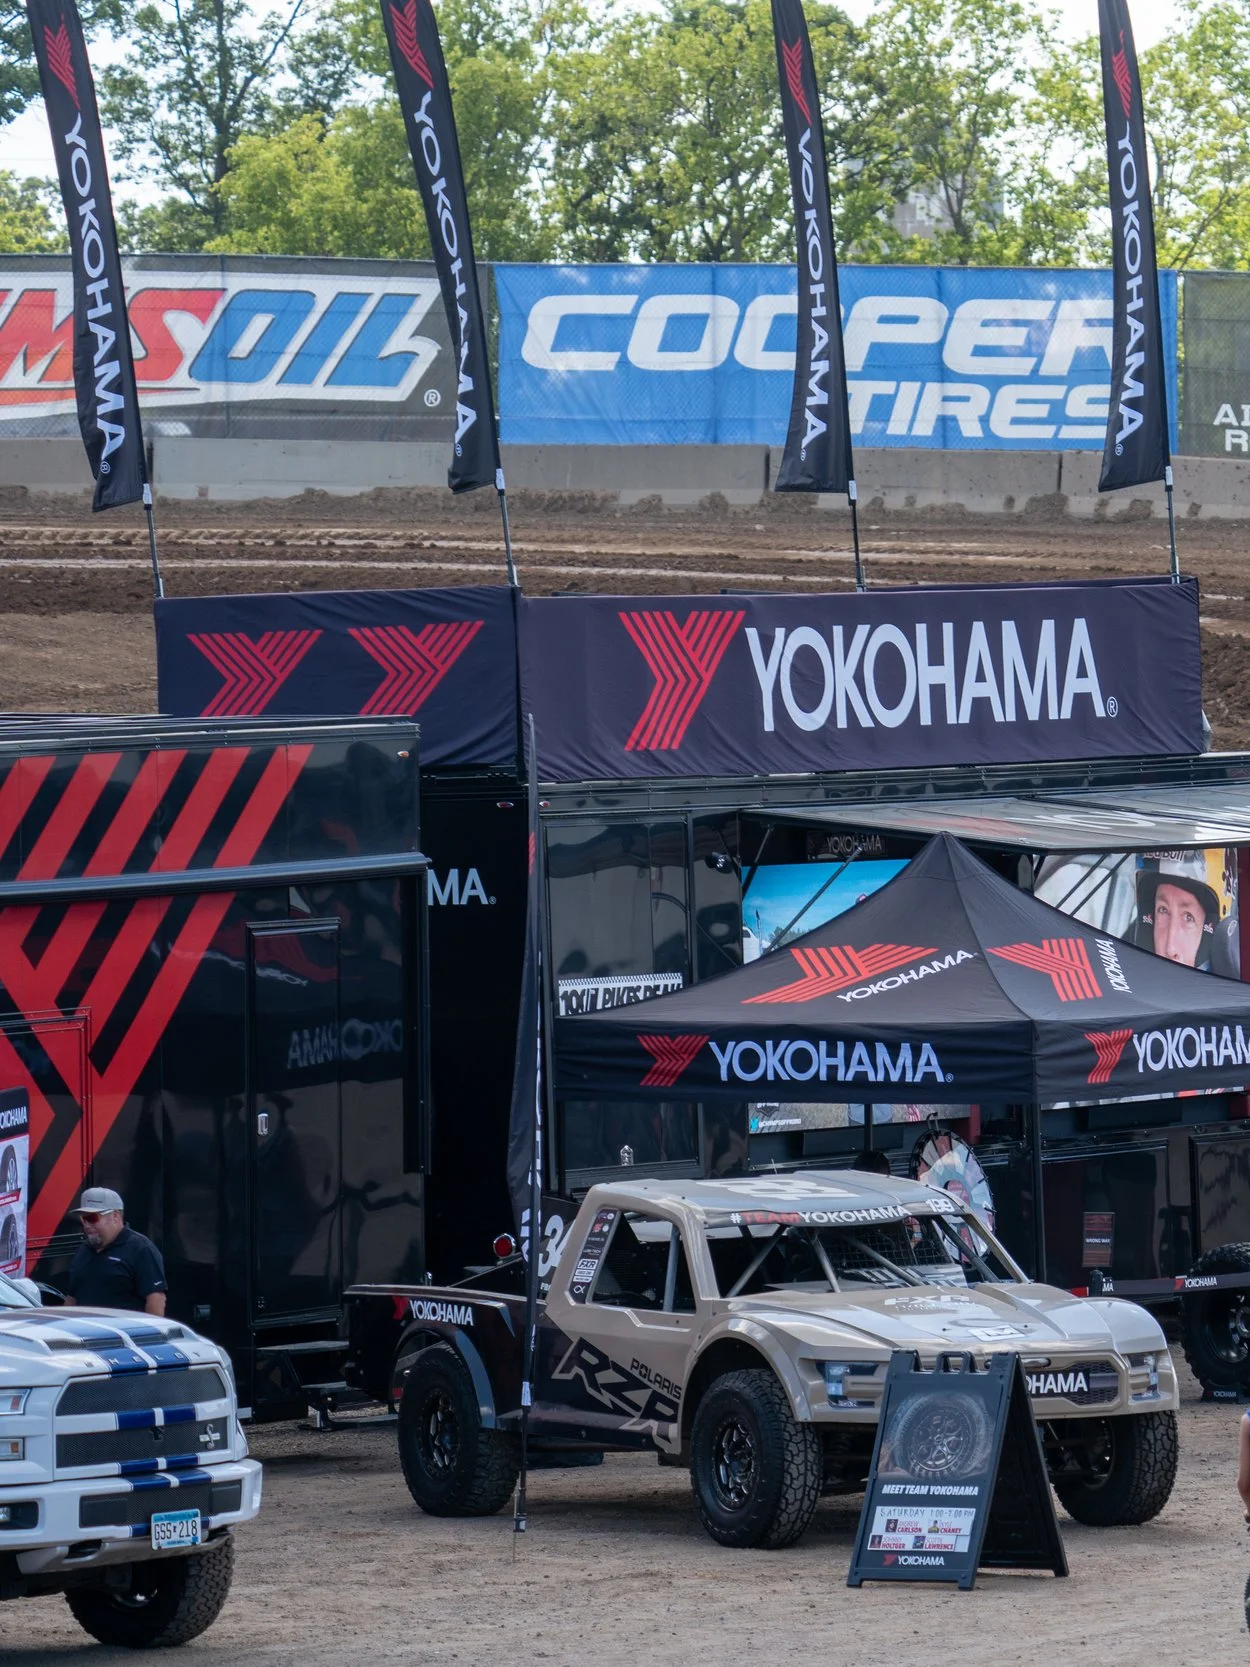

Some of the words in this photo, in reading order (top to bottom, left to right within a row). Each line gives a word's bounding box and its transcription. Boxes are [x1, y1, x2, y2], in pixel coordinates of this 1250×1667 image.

[64, 112, 126, 462] YOKOHAMA
[413, 91, 478, 444] YOKOHAMA
[796, 128, 829, 449] YOKOHAMA
[1115, 121, 1146, 445] YOKOHAMA
[745, 617, 1107, 732] YOKOHAMA
[837, 949, 973, 1003] YOKOHAMA
[1095, 938, 1133, 993] YOKOHAMA
[708, 1038, 945, 1084] YOKOHAMA
[925, 1198, 955, 1213] 199
[580, 1260, 597, 1268] FXR
[1184, 1276, 1218, 1288] YOKOHAMA
[409, 1299, 474, 1327] YOKOHAMA
[551, 1335, 683, 1456] RZR
[630, 1358, 683, 1400] POLARIS
[881, 1484, 905, 1495] MEET
[905, 1485, 928, 1495] TEAM
[929, 1486, 979, 1496] YOKOHAMA
[154, 1522, 172, 1541] GSS
[179, 1519, 198, 1539] 218
[880, 1508, 925, 1517] SATURDAY
[898, 1556, 945, 1566] YOKOHAMA
